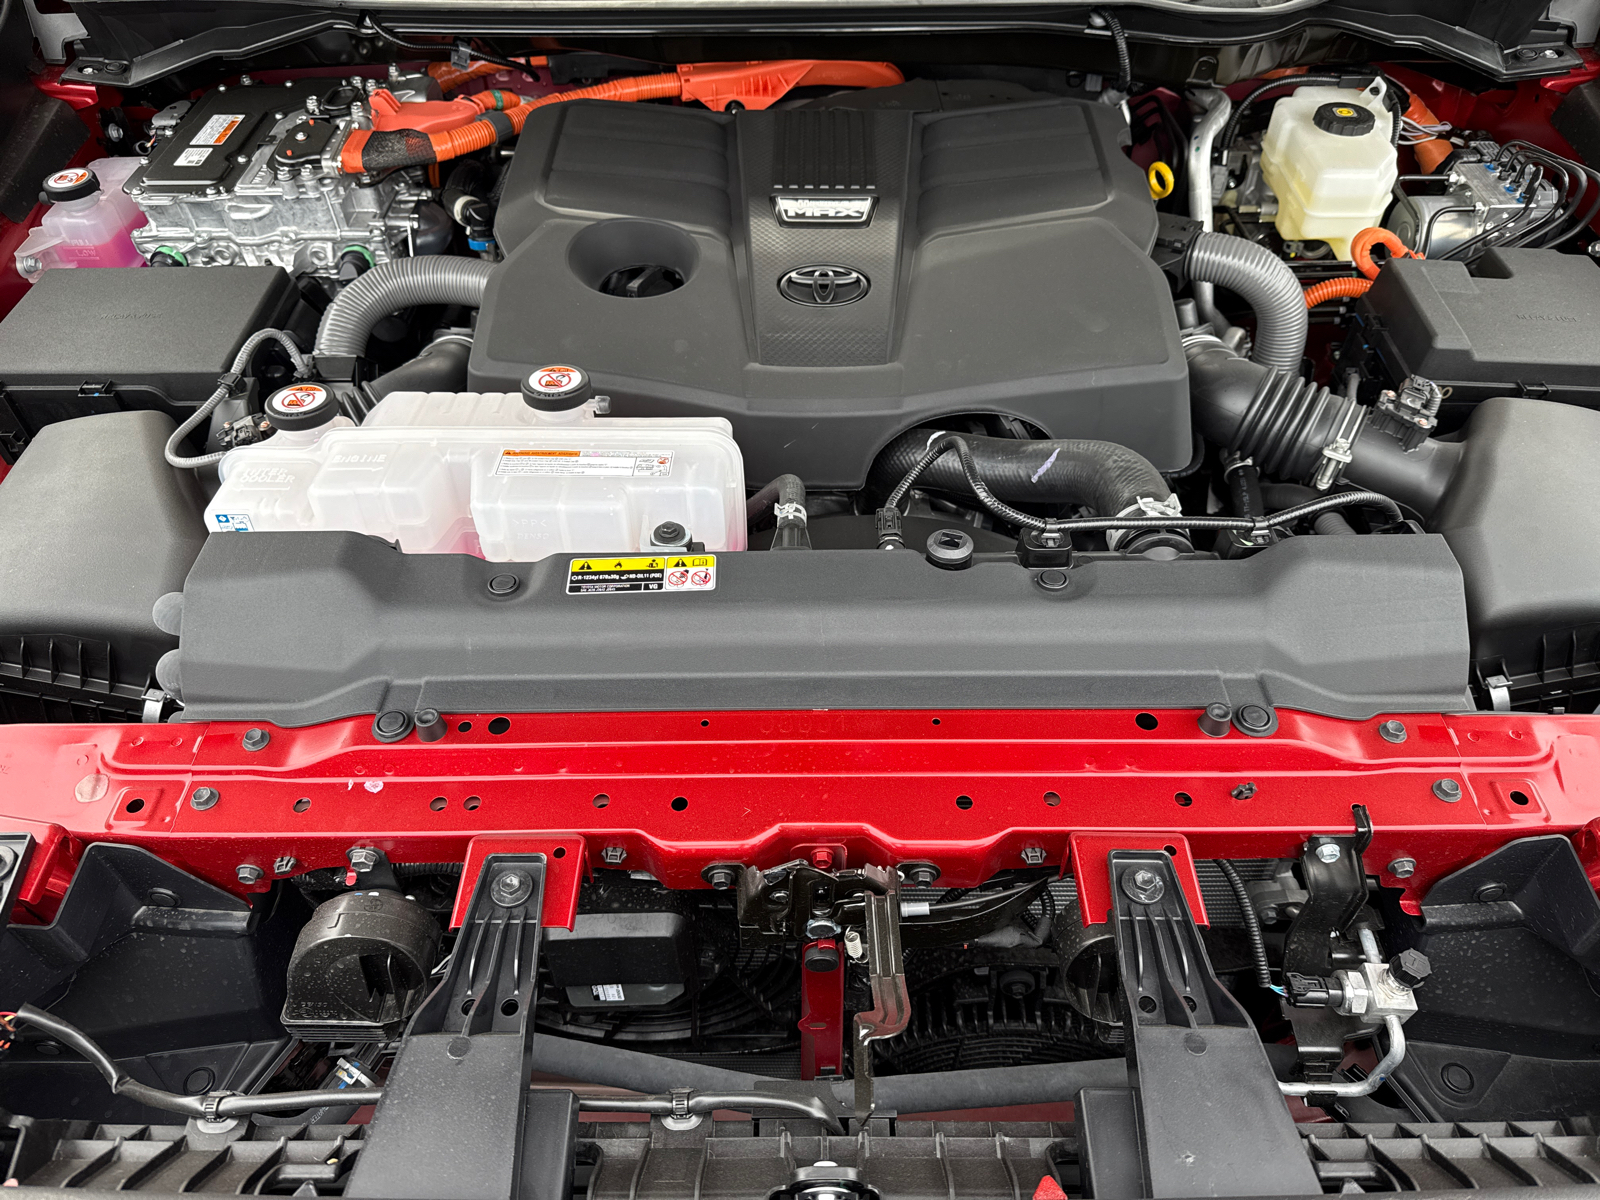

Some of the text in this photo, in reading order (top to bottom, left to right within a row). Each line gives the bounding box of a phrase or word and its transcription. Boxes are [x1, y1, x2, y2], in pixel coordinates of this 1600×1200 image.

[785, 207, 864, 217] MAX
[75, 249, 97, 257] LOW
[332, 454, 388, 464] ENGINE
[517, 532, 550, 541] DENSO
